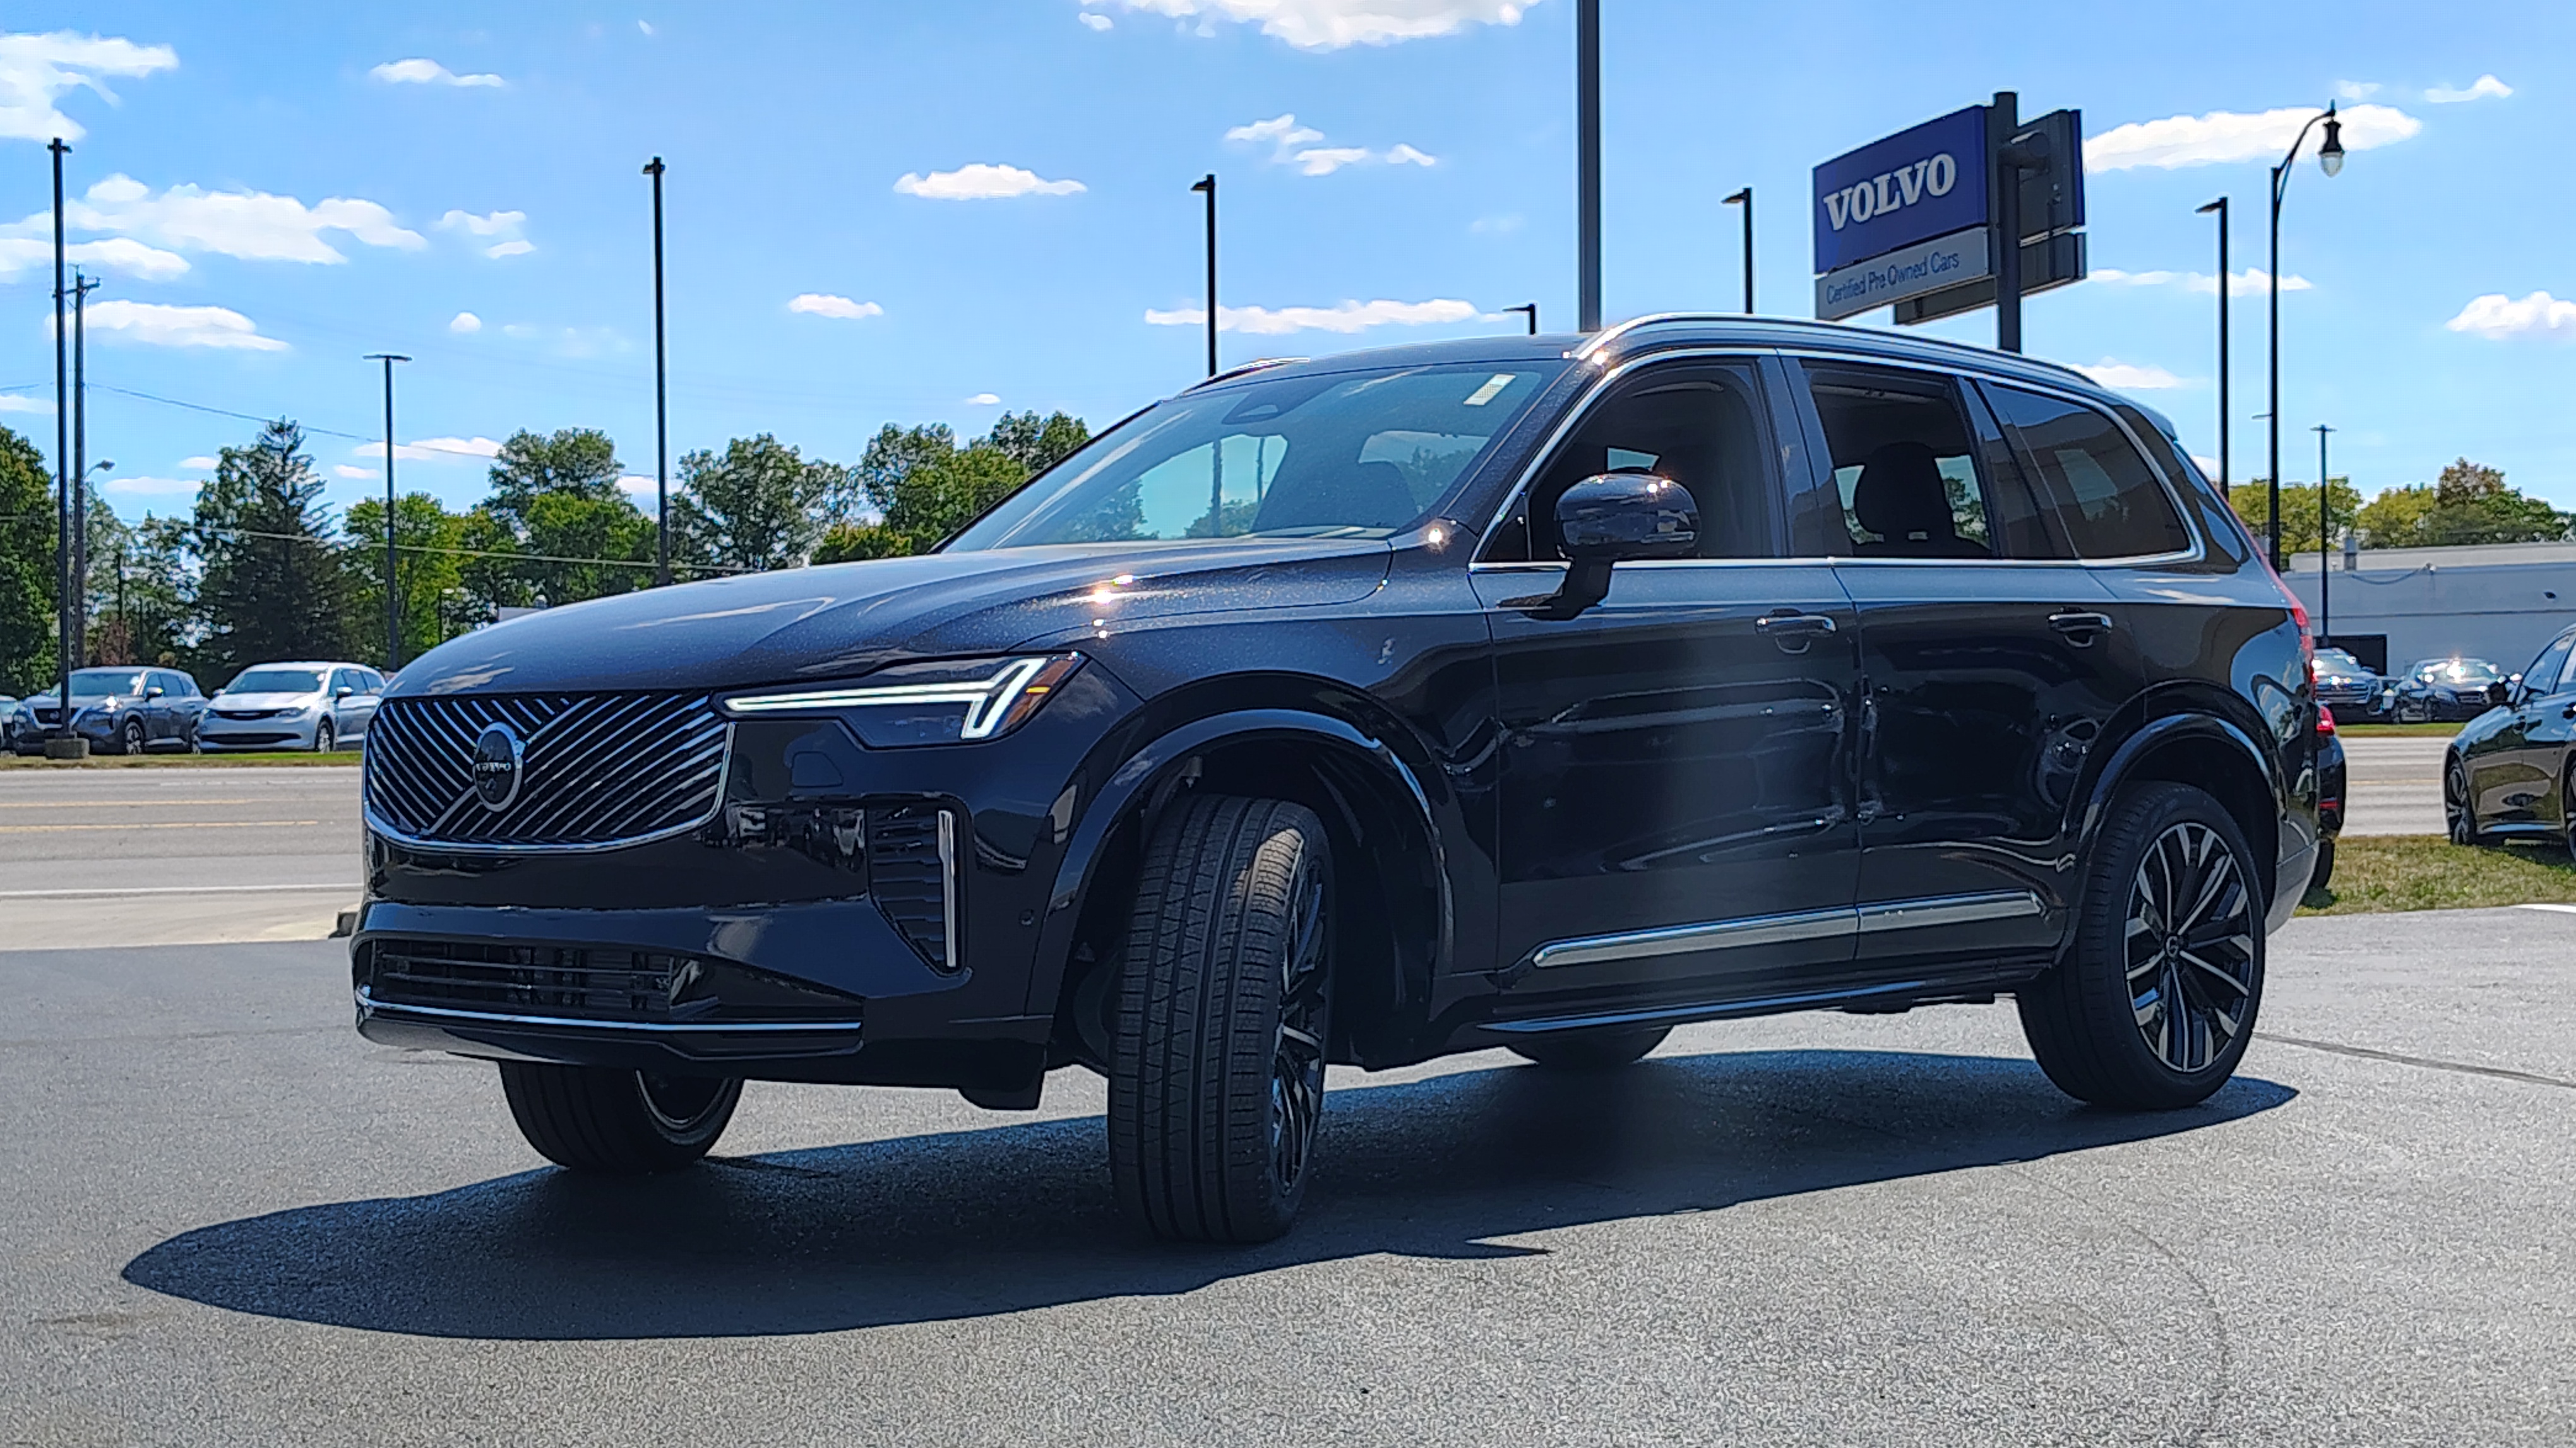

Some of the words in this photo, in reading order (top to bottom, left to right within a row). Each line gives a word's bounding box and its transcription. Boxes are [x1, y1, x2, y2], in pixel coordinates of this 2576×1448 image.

[1823, 153, 1956, 231] VOLVO
[1827, 274, 1866, 304] Certified
[1868, 271, 1886, 292] Pre
[1887, 257, 1928, 286] Owned
[1930, 252, 1960, 274] Cars
